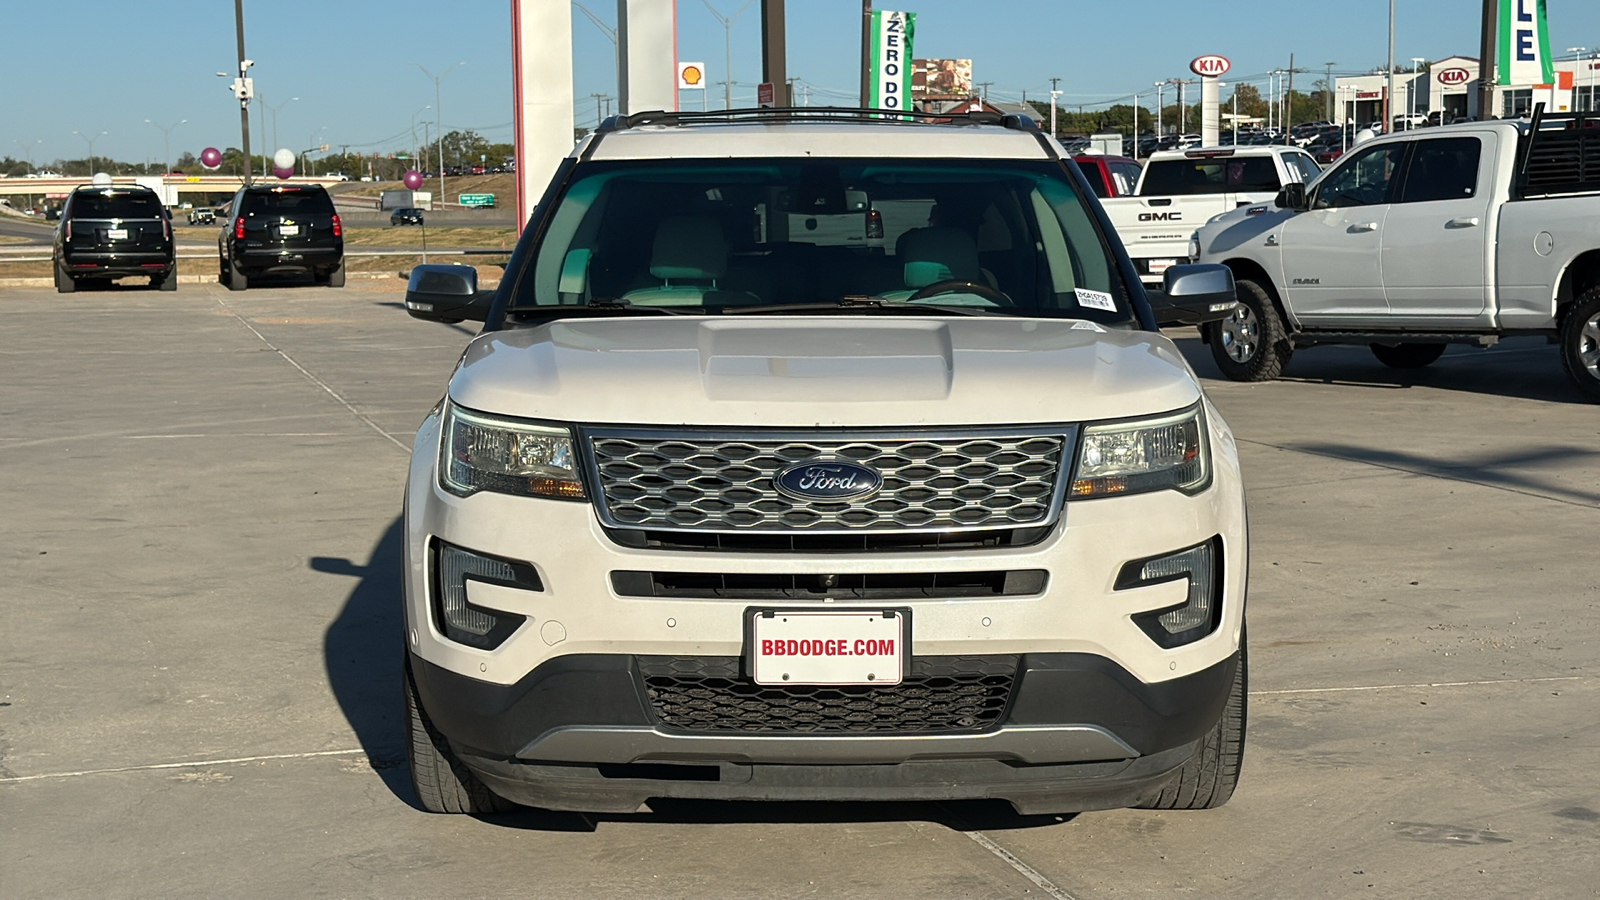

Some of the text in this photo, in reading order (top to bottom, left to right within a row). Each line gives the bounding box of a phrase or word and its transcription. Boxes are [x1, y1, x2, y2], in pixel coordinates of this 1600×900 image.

[884, 20, 899, 76] ZERO
[1199, 60, 1224, 71] KIA
[1443, 71, 1464, 81] KIA
[1138, 212, 1182, 221] GMC
[799, 466, 857, 490] Ford
[762, 639, 895, 656] BBDODGE.COM
